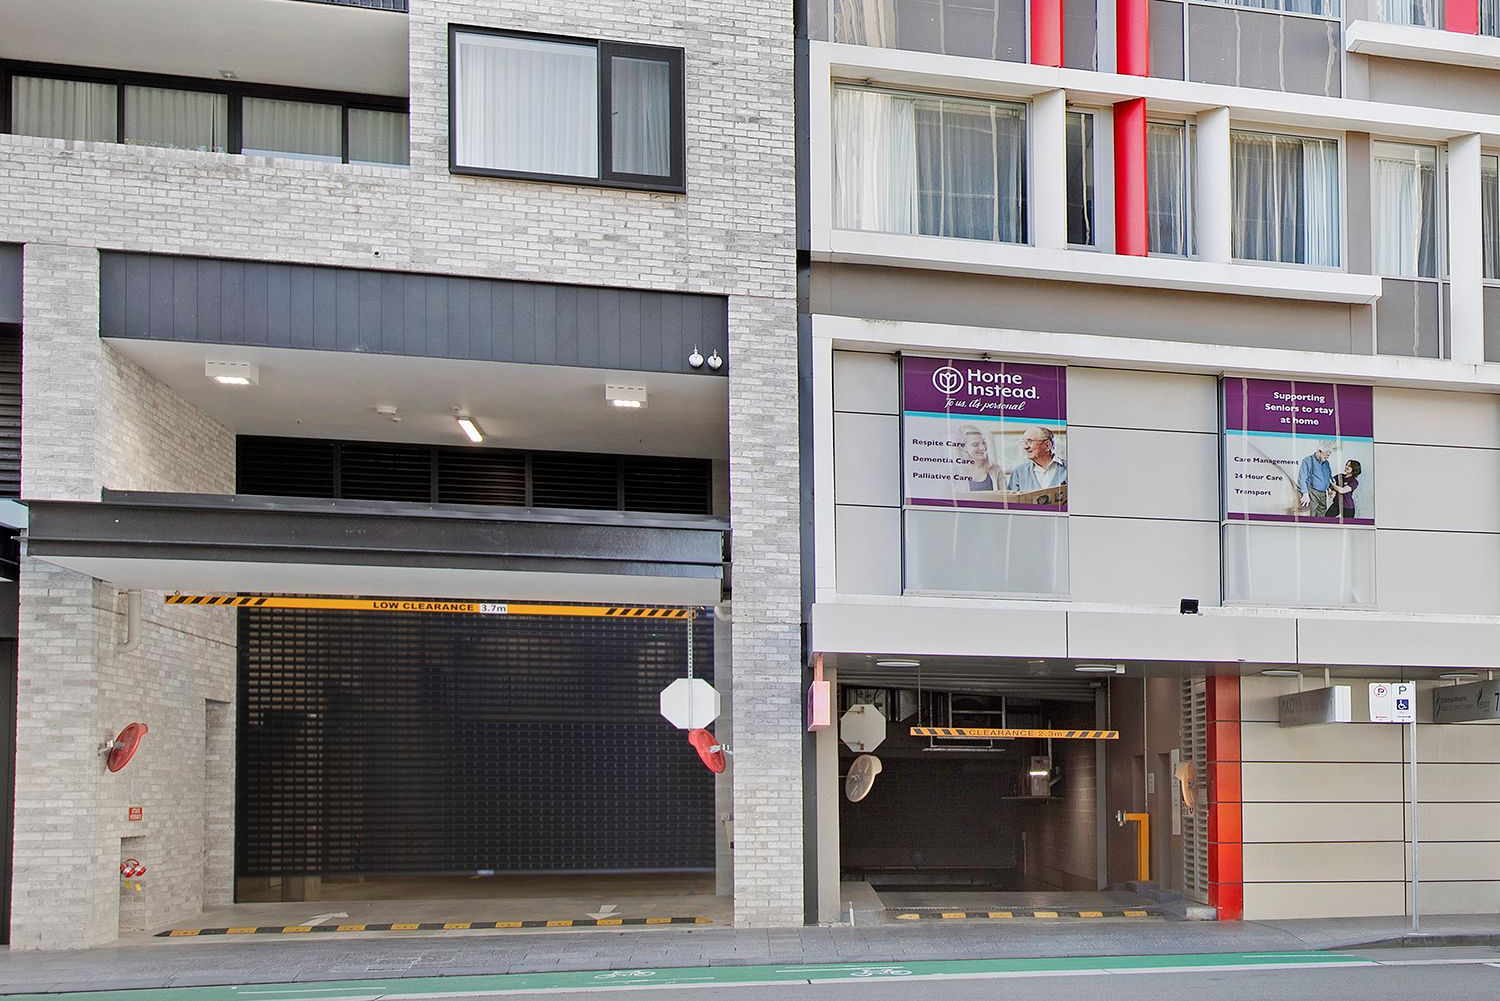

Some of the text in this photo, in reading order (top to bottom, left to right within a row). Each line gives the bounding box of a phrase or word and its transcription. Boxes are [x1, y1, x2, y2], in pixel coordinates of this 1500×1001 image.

[967, 368, 1023, 385] Home
[967, 382, 1040, 399] Instead.
[1273, 391, 1326, 404] Supporting
[945, 397, 955, 408] To
[955, 400, 967, 408] us,
[980, 401, 1027, 412] personal
[1264, 403, 1300, 413] Seniors
[1314, 407, 1334, 416] stay
[1292, 417, 1320, 426] home
[912, 438, 944, 448] Respite
[912, 455, 954, 464] Dementia
[1253, 457, 1300, 466] Management
[912, 472, 973, 482] Palliative Care
[1234, 488, 1272, 496] Transport
[373, 601, 507, 612] LOW CLEARANCE 3.7m
[1494, 692, 1500, 712] 7
[968, 729, 1034, 737] CLEARANCE
